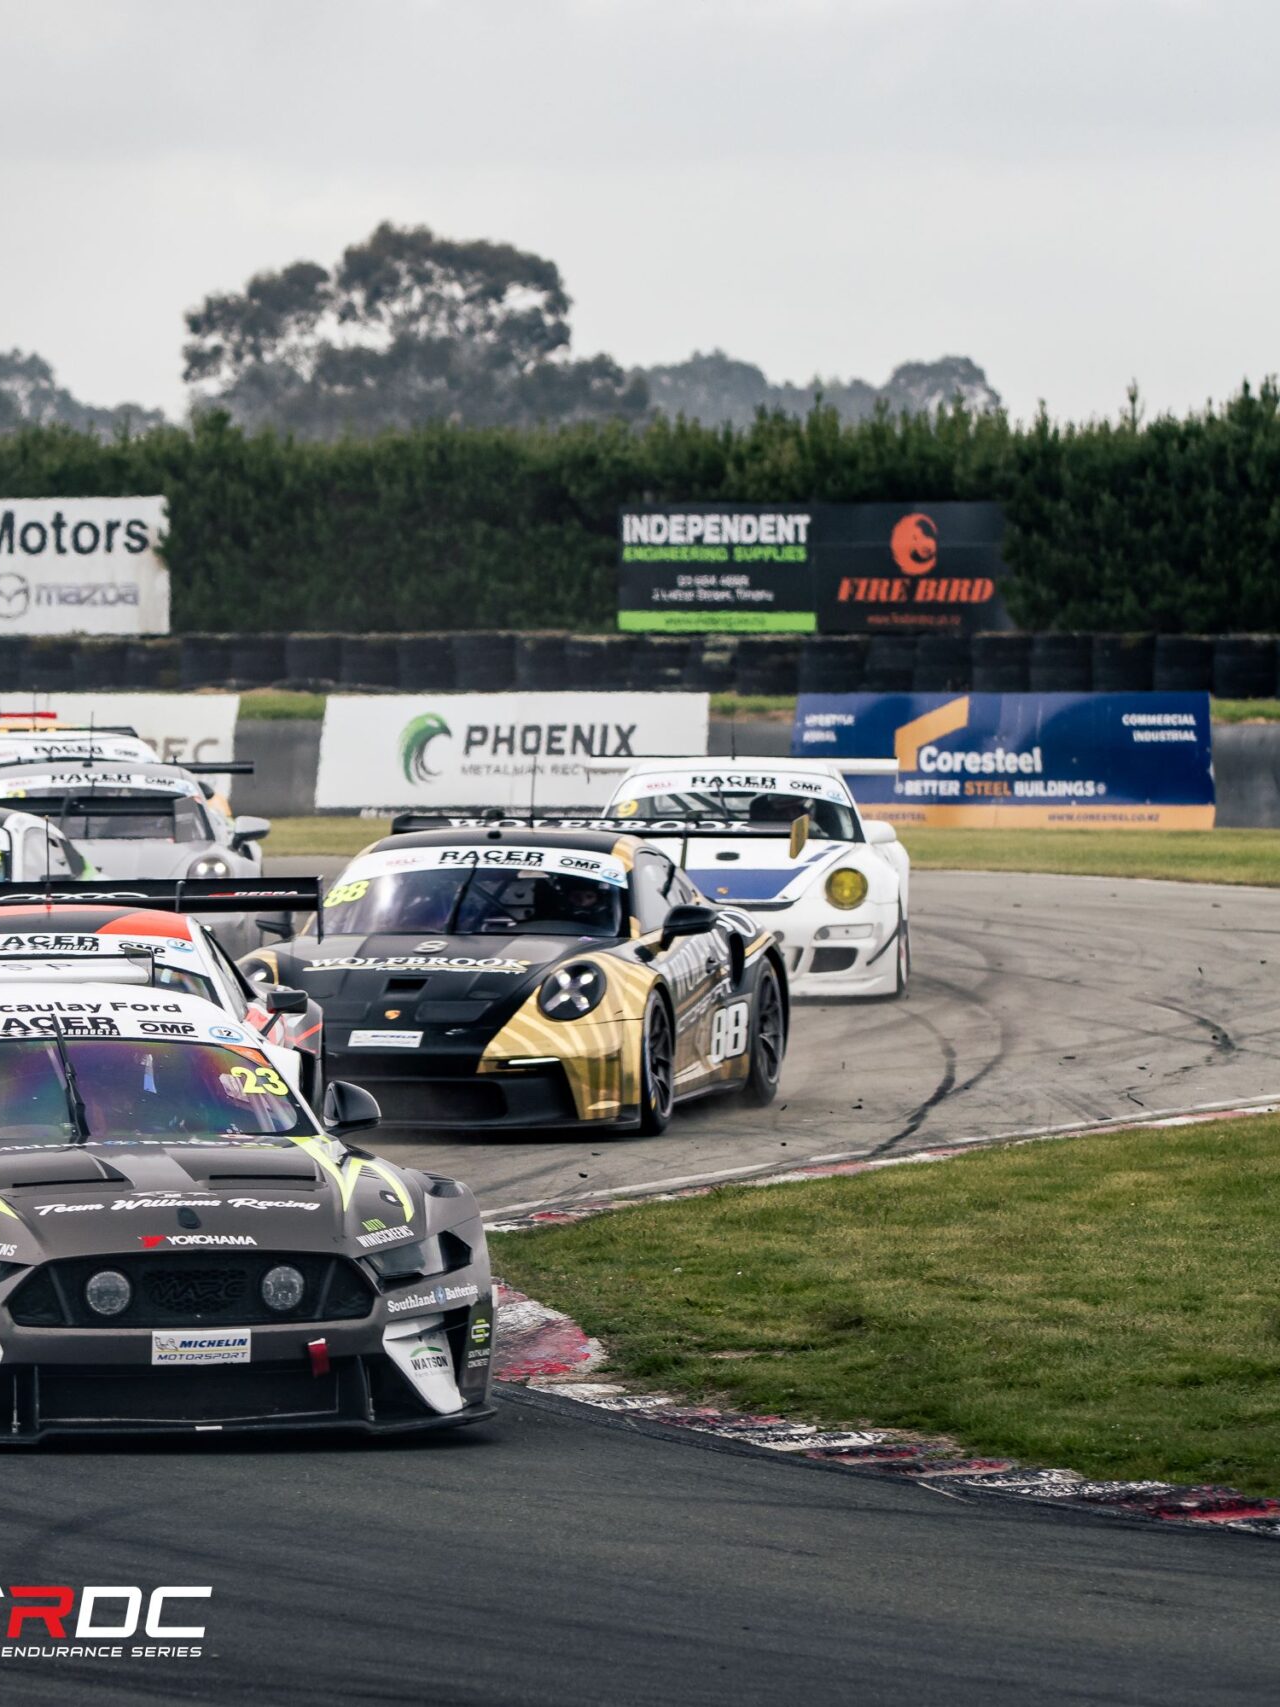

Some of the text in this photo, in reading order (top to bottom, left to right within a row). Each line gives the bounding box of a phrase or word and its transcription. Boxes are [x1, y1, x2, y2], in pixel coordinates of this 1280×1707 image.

[623, 514, 811, 544] INDEPENDENT
[622, 546, 807, 562] ENGINEERING SUPPLIES
[35, 582, 139, 607] mazda
[837, 577, 994, 604] FIRE BIRD
[1122, 713, 1197, 727] COMMERCIAL
[463, 723, 638, 757] PHOENIX
[1132, 730, 1198, 743] INDUSTRIAL
[920, 745, 1042, 773] Coresteel
[460, 763, 545, 776] METALMAN
[691, 775, 777, 787] RACER
[789, 780, 823, 790] OMP
[904, 780, 1096, 797] BETTER STEEL BUILDINGS
[439, 850, 544, 864] RACER
[560, 857, 601, 870] OMP
[308, 956, 527, 970] WOLFBROOK
[111, 1001, 182, 1013] Ford
[59, 1028, 119, 1036] PRODUCTS
[140, 1023, 195, 1034] OMP
[710, 1001, 749, 1064] 88
[230, 1066, 289, 1096] 23
[33, 1198, 321, 1215] Team Williams Racing
[166, 1234, 257, 1246] YOKOHAMA
[356, 1225, 415, 1248] WINDSCREENS
[387, 1282, 479, 1313] Southland Batteries
[179, 1338, 248, 1349] MICHELIN
[157, 1351, 248, 1361] MOTORSPORT
[467, 1349, 490, 1359] SOUTHLAND
[410, 1355, 449, 1371] WATSON
[467, 1358, 489, 1368] CONCRETE
